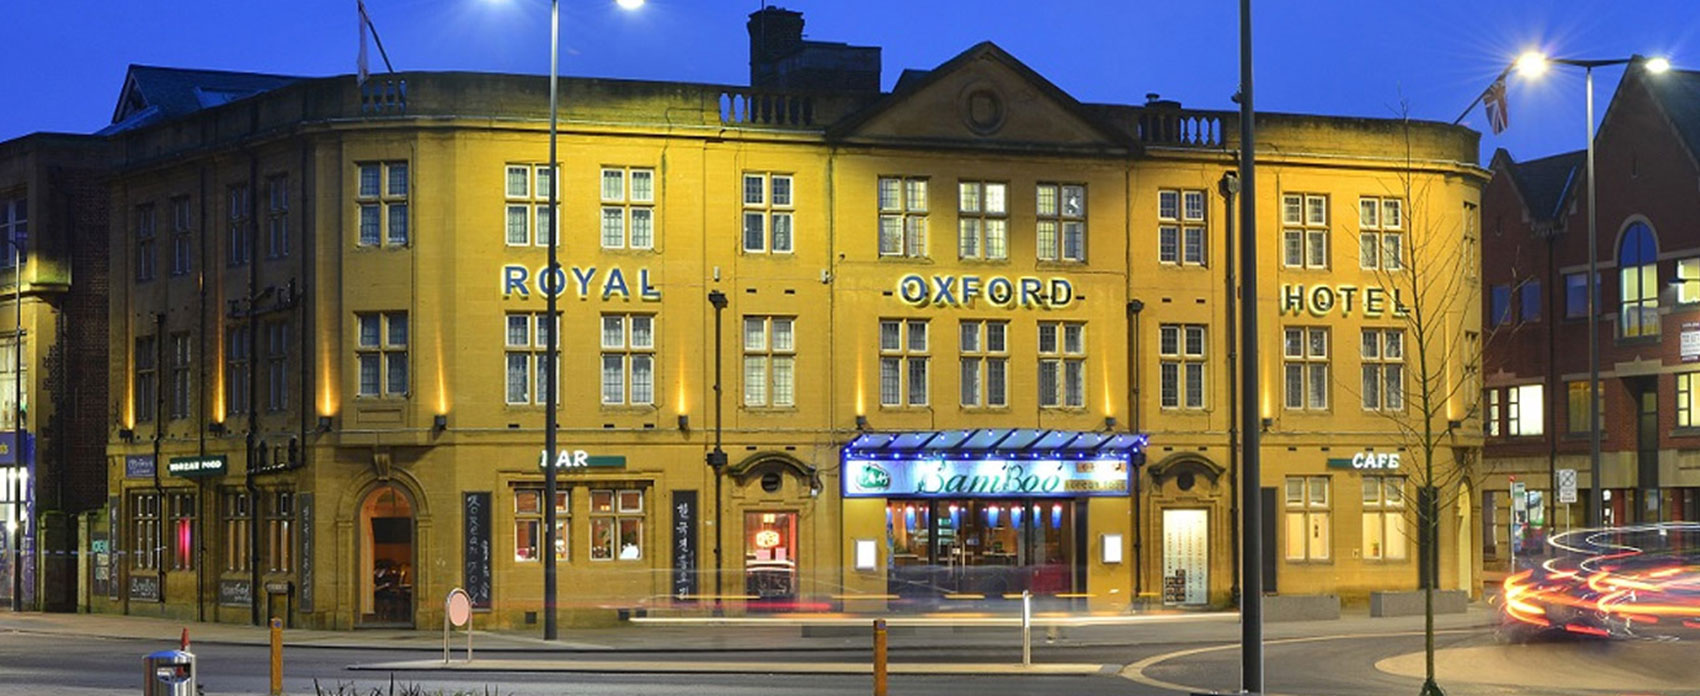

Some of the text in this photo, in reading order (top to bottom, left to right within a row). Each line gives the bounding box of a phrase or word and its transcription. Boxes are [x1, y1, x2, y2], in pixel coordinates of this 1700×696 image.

[502, 265, 1411, 318] ROYAL OXFORD HOTEL
[1352, 452, 1399, 468] CAFE
